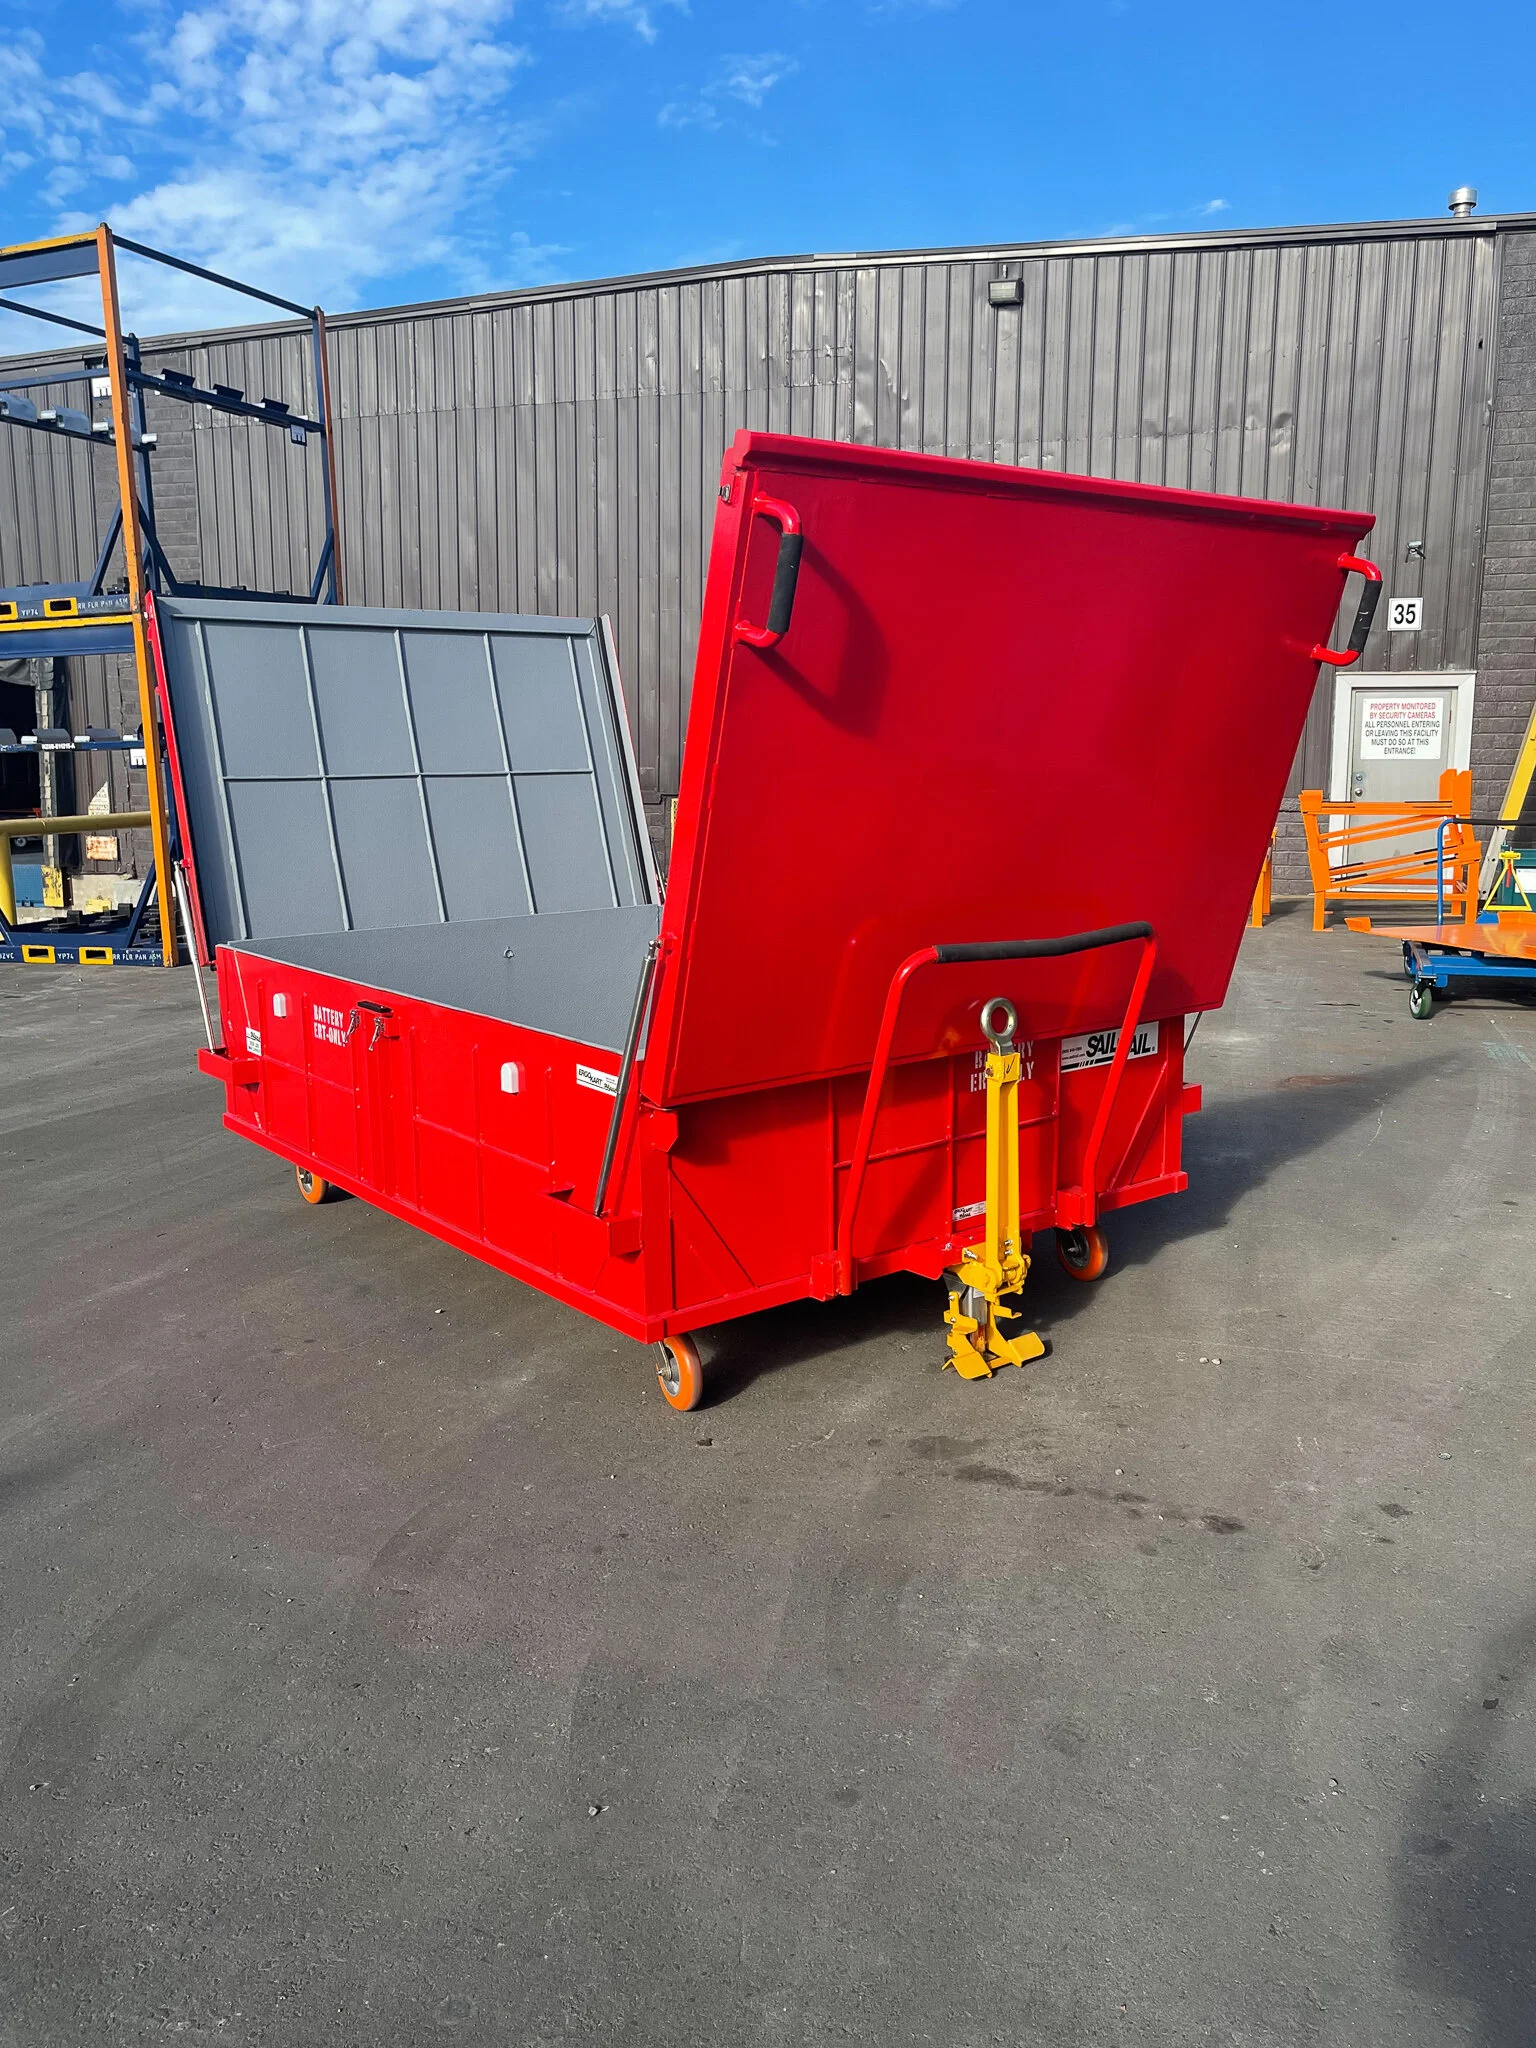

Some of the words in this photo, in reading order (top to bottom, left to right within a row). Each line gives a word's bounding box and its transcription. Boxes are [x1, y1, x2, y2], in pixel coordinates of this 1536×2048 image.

[1394, 604, 1415, 624] 35
[1401, 702, 1436, 710] MONITORED
[1412, 720, 1440, 728] ENTERING
[314, 1004, 343, 1028] BATTERY
